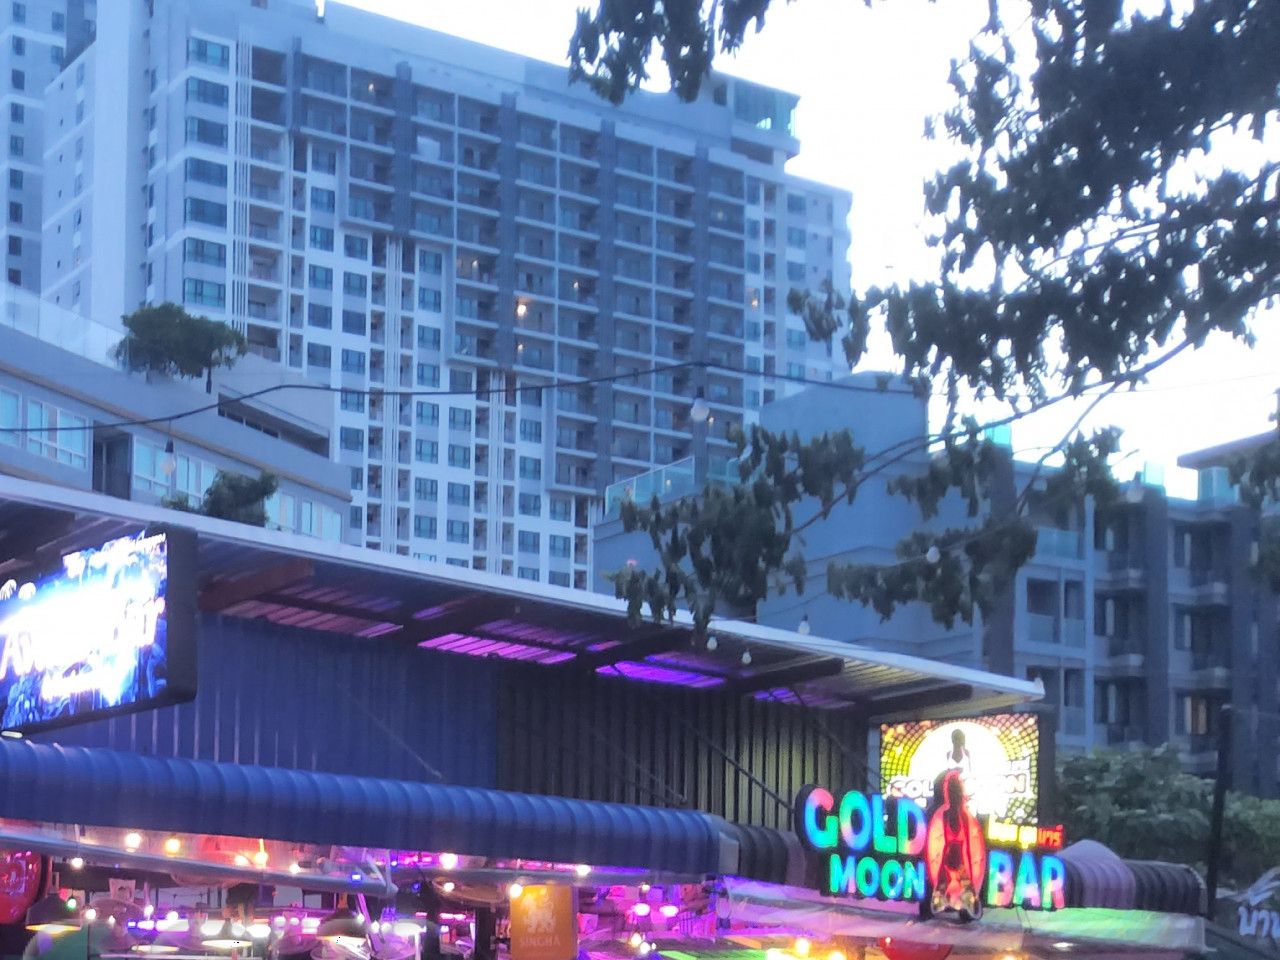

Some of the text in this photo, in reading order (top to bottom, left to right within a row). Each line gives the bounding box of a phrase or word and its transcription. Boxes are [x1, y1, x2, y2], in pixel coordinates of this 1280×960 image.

[804, 787, 928, 855] GOLD
[829, 854, 926, 899] MOON
[987, 850, 1066, 909] BAR
